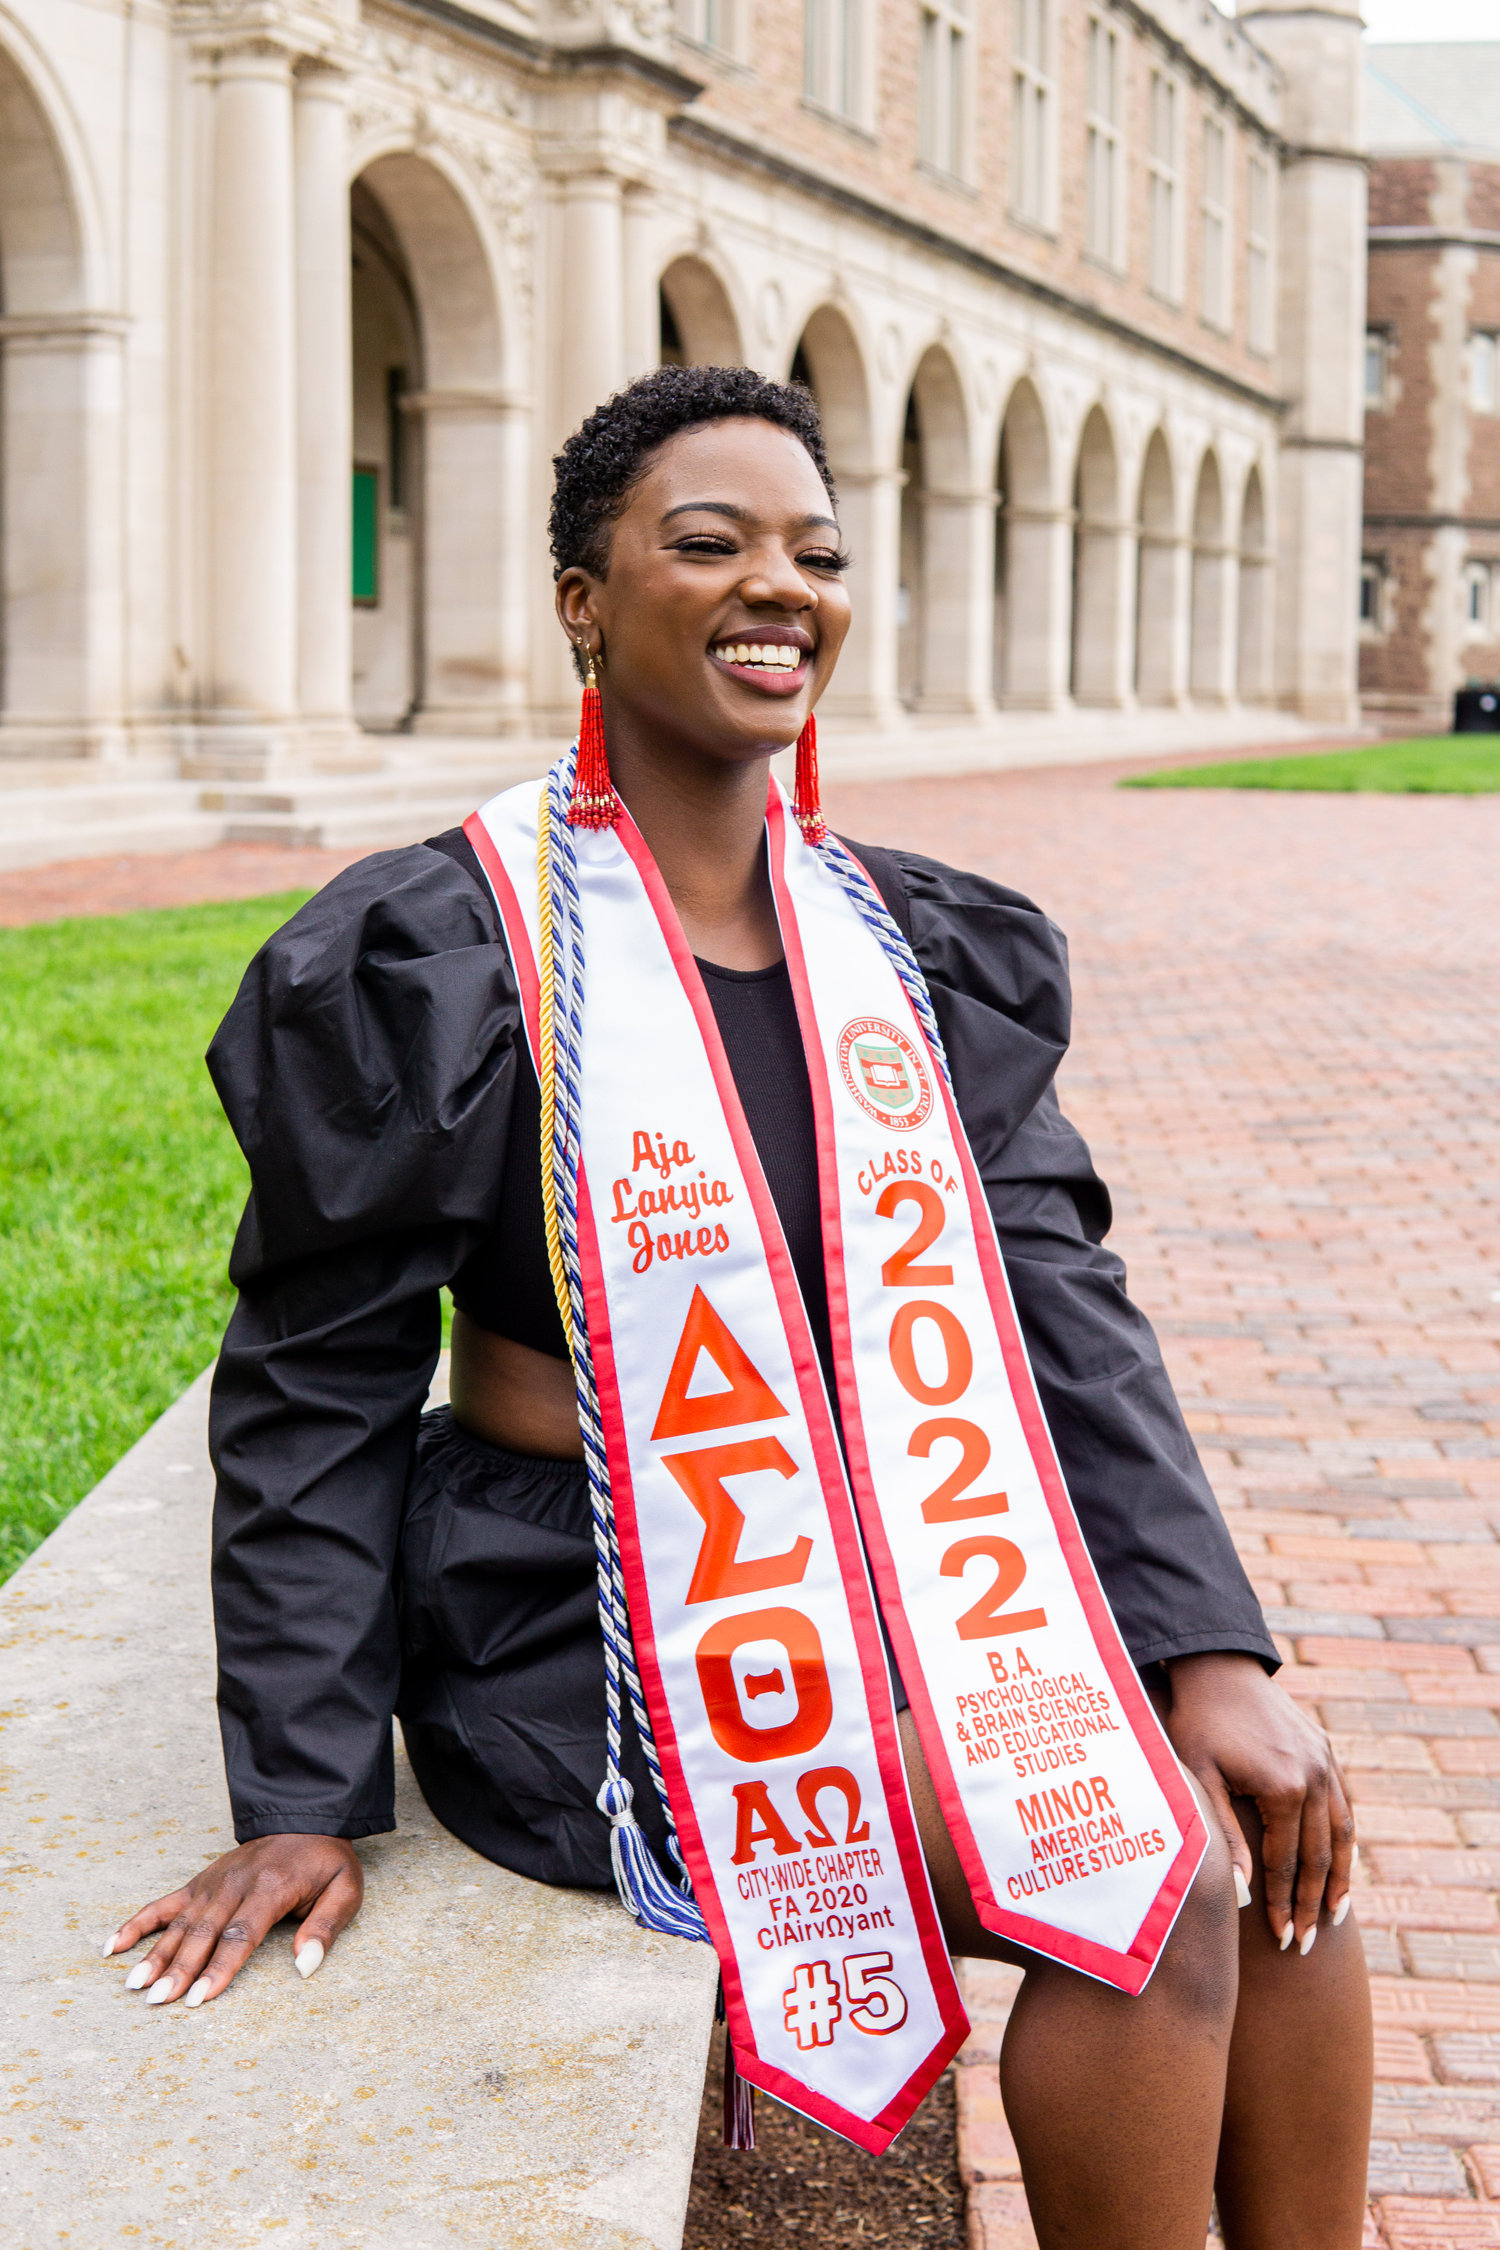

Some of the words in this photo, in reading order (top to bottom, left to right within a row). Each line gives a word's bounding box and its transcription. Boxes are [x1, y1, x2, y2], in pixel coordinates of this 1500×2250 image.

[846, 1022, 904, 1045] UNIVERSITY
[906, 1049, 919, 1063] IN
[889, 1117, 909, 1127] 1853
[632, 1130, 695, 1180] Aja
[858, 1149, 922, 1195] CLASS
[931, 1159, 958, 1194] OF
[611, 1171, 734, 1223] Lanyia
[628, 1221, 729, 1274] Jones
[875, 1179, 1048, 1641] 2022
[986, 1646, 1042, 1684] B.A.
[956, 1672, 1093, 1717] PSYCHOLOGICAL
[956, 1721, 972, 1742] &
[972, 1701, 1027, 1737] BRAIN
[1027, 1691, 1110, 1724] SCIENCES
[965, 1738, 1000, 1766] AND
[1002, 1713, 1120, 1755] EDUCATIONAL
[1014, 1743, 1087, 1778] STUDIES
[1015, 1775, 1116, 1836] MINOR
[1030, 1812, 1125, 1864] AMERICAN
[737, 1859, 816, 1900] CITY-WIDE
[816, 1848, 884, 1884] CHAPTER
[1007, 1853, 1089, 1900] CULTURE
[1088, 1829, 1166, 1873] STUDIES
[769, 1896, 801, 1921] FA
[806, 1883, 867, 1913] 2020
[783, 1951, 908, 2050] #5
